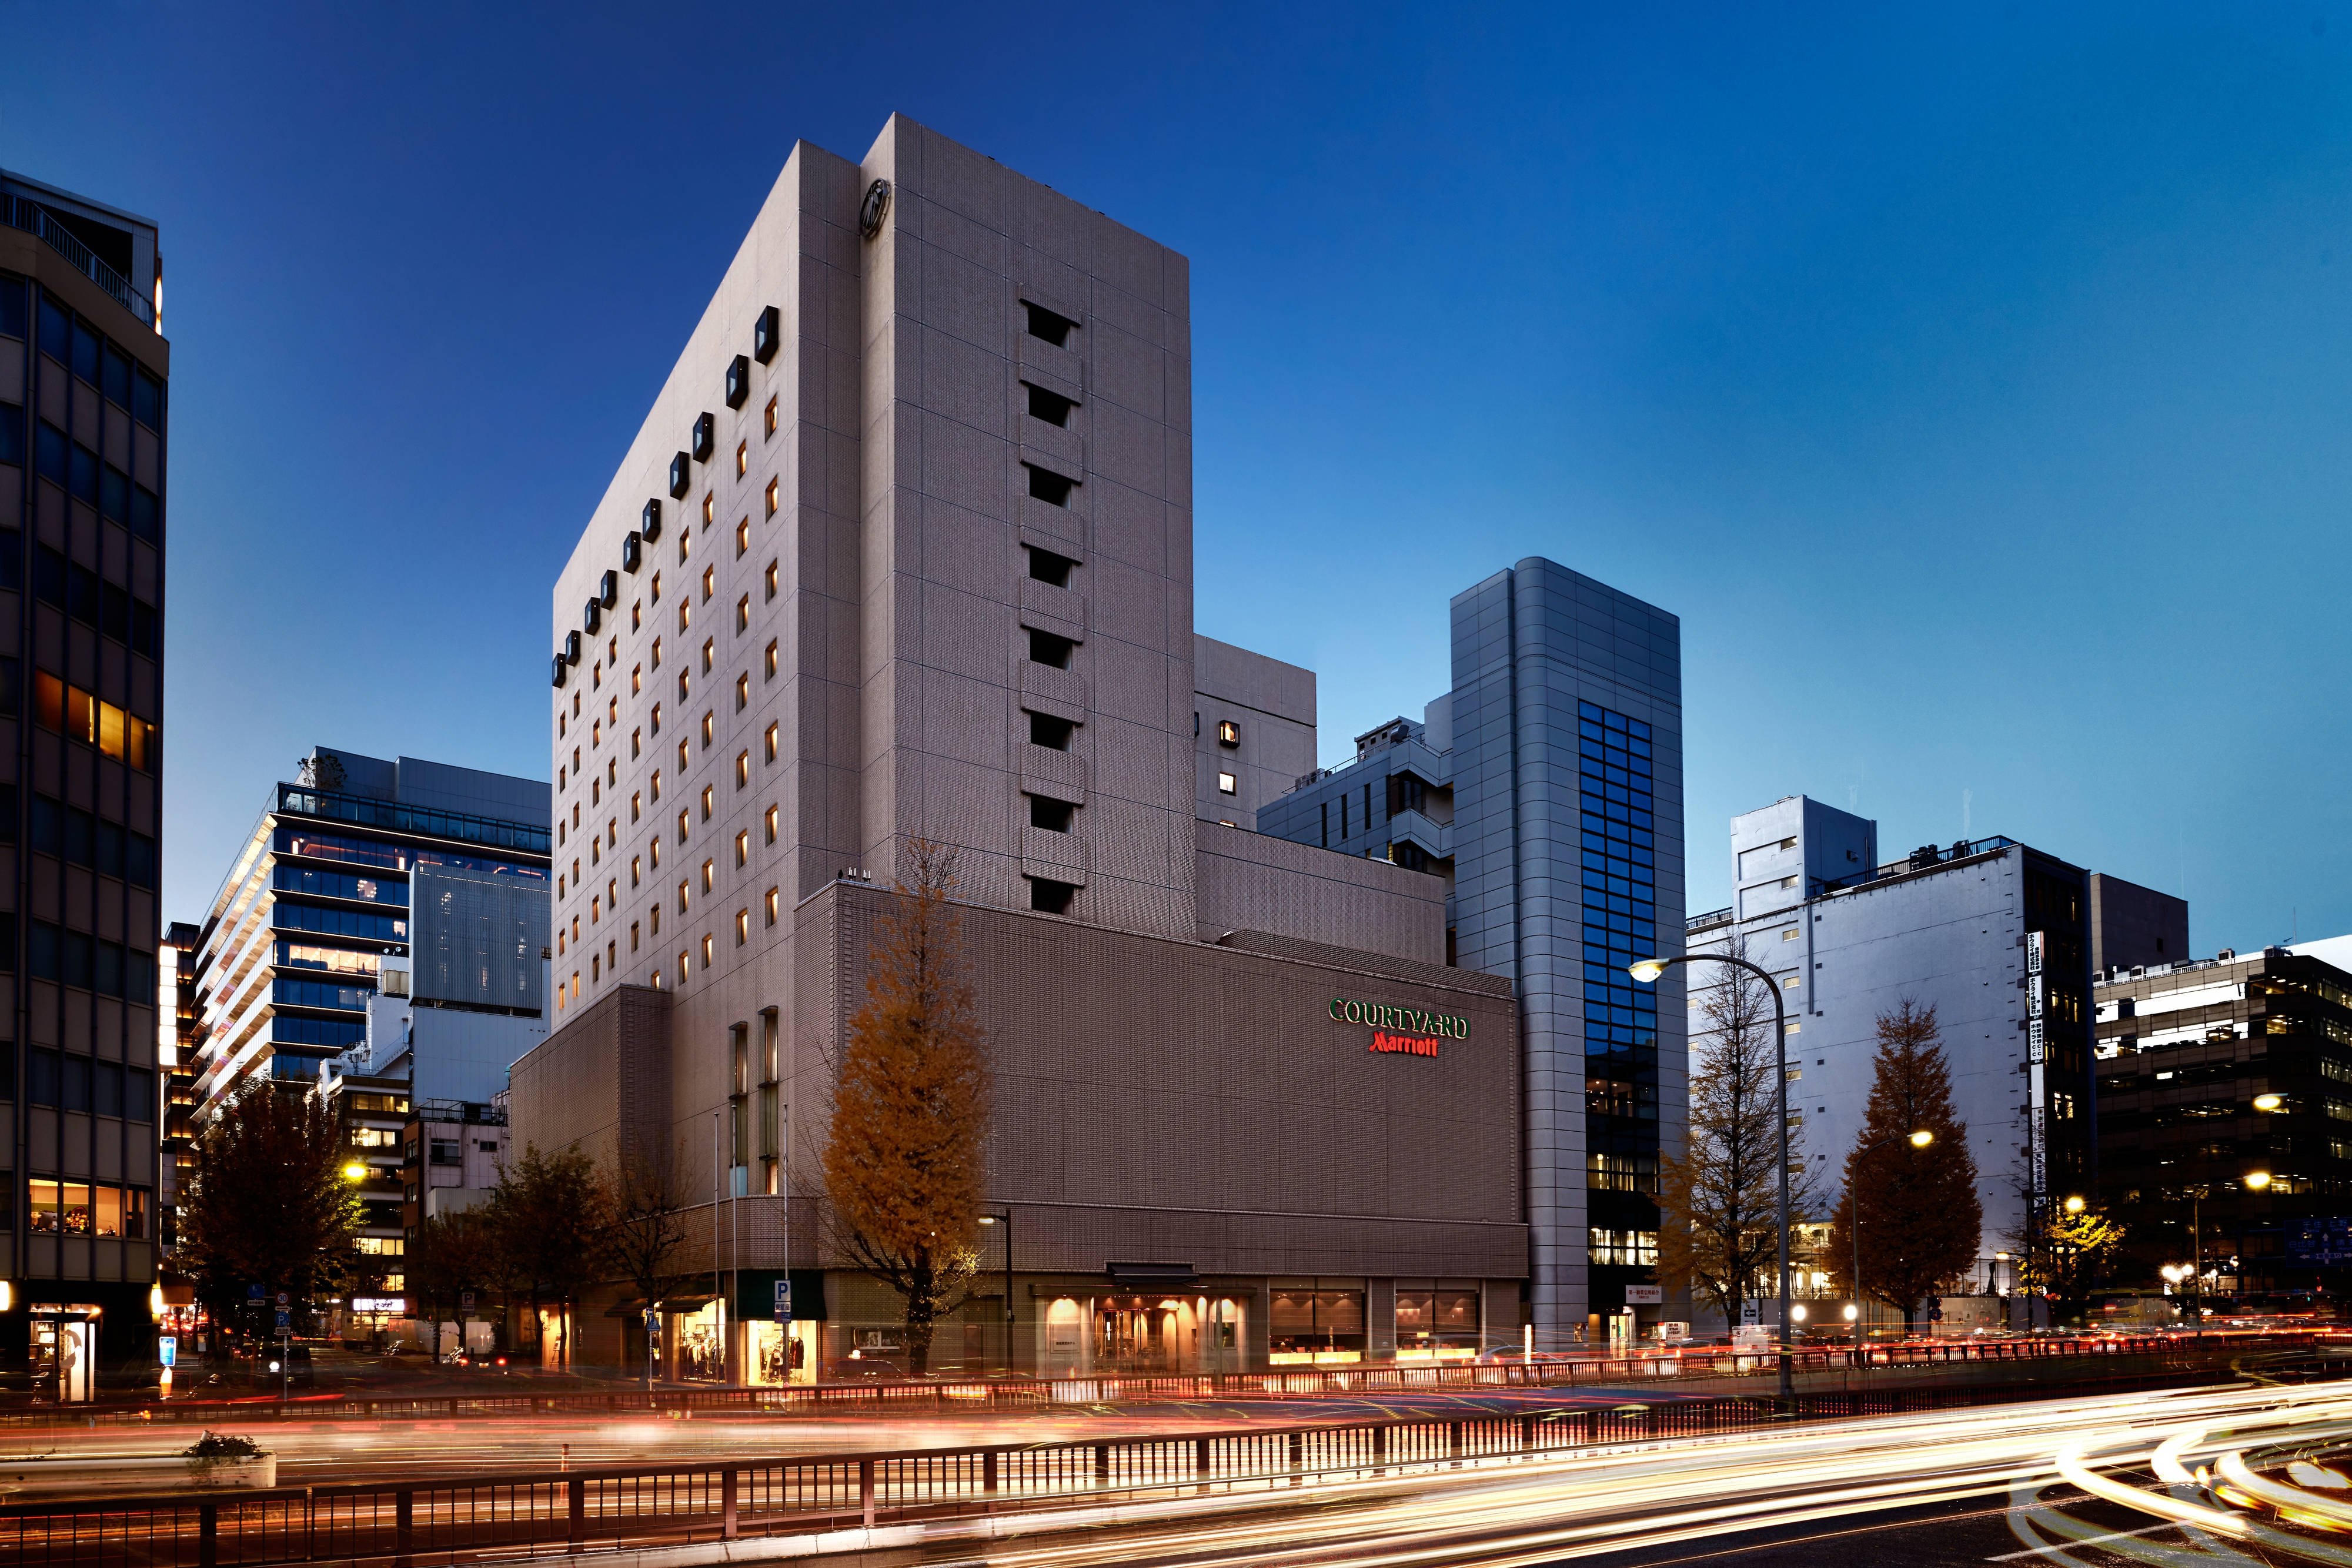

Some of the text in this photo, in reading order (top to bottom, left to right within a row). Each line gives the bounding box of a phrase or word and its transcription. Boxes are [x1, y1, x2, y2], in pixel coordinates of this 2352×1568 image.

[1329, 997, 1470, 1039] COURTYARD
[1368, 1031, 1438, 1057] Marriott
[465, 1293, 472, 1303] P
[778, 1283, 788, 1299] P
[278, 1315, 285, 1325] P
